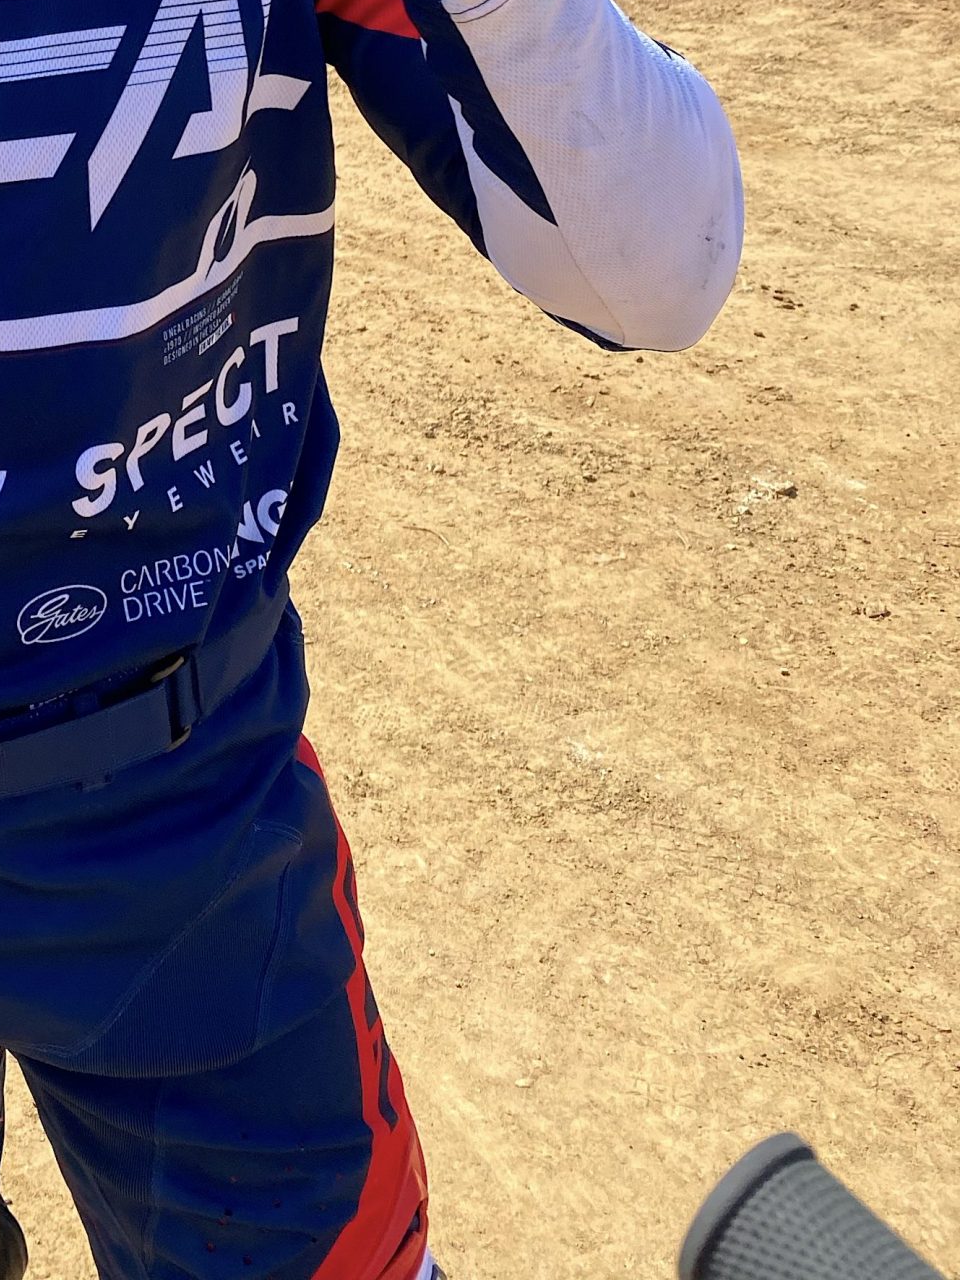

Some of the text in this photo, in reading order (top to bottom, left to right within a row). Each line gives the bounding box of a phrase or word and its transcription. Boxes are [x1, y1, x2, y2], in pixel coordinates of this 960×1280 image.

[71, 317, 299, 518] SPECT
[120, 545, 232, 594] CARBON
[234, 550, 272, 580] SPA
[22, 593, 102, 644] Gates
